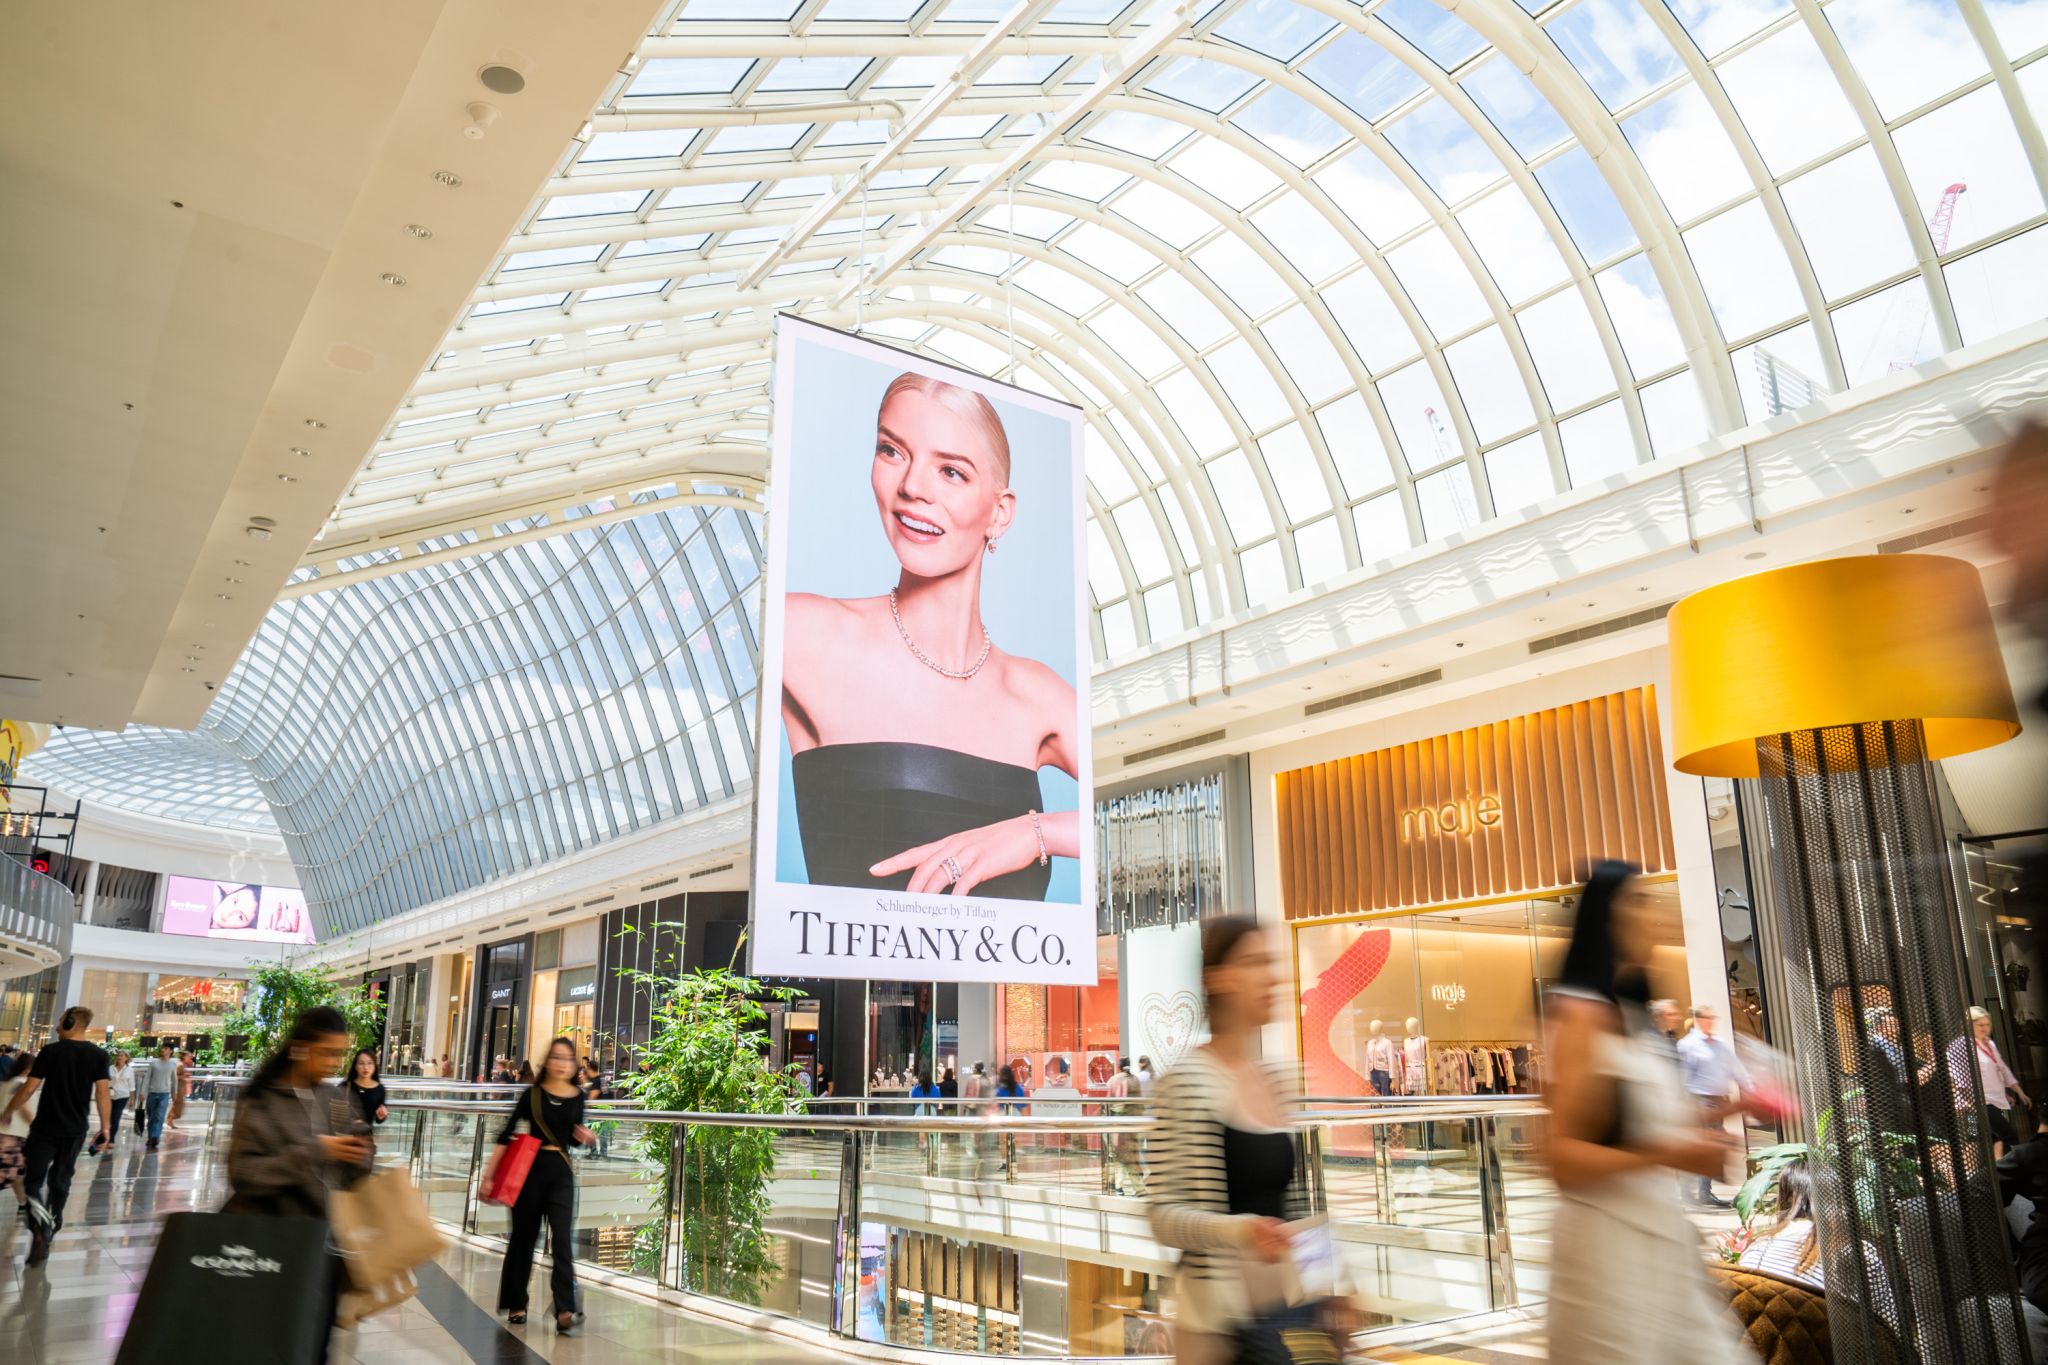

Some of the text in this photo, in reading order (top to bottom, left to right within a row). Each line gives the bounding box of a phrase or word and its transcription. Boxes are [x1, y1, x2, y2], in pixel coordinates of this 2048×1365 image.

[1401, 789, 1501, 840] maje
[875, 898, 998, 921] Schlumberger by Tiffany
[789, 910, 969, 961] TIFFANY
[975, 925, 1004, 963] &
[492, 988, 511, 999] GANT
[1432, 982, 1466, 1010] maje
